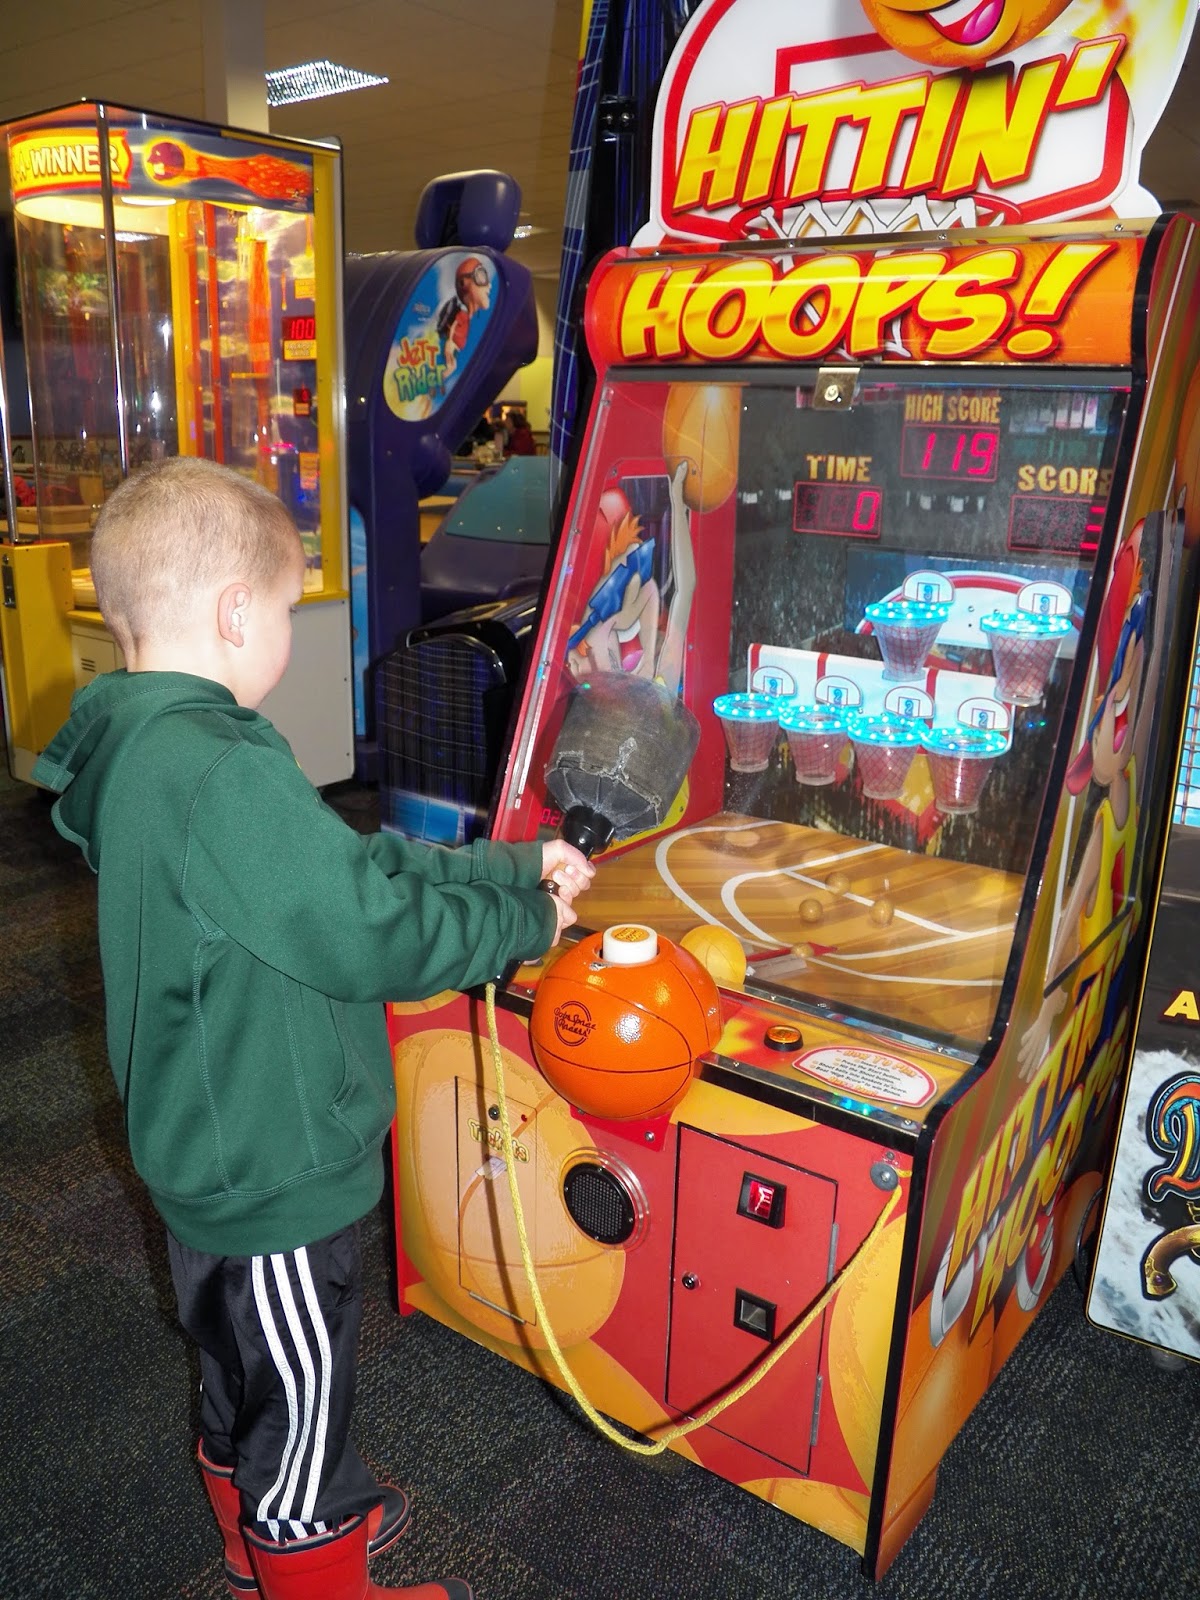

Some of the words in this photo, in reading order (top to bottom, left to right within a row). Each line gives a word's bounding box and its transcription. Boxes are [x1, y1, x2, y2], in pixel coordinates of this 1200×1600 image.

[671, 33, 1127, 213] HITTIN'
[618, 242, 1118, 361] HOOPS!
[291, 318, 315, 340] 100
[904, 393, 944, 422] HIGH
[948, 395, 1003, 425] SCORE
[806, 454, 873, 483] TIME
[921, 432, 998, 475] 119
[468, 1118, 530, 1164] Tickts
